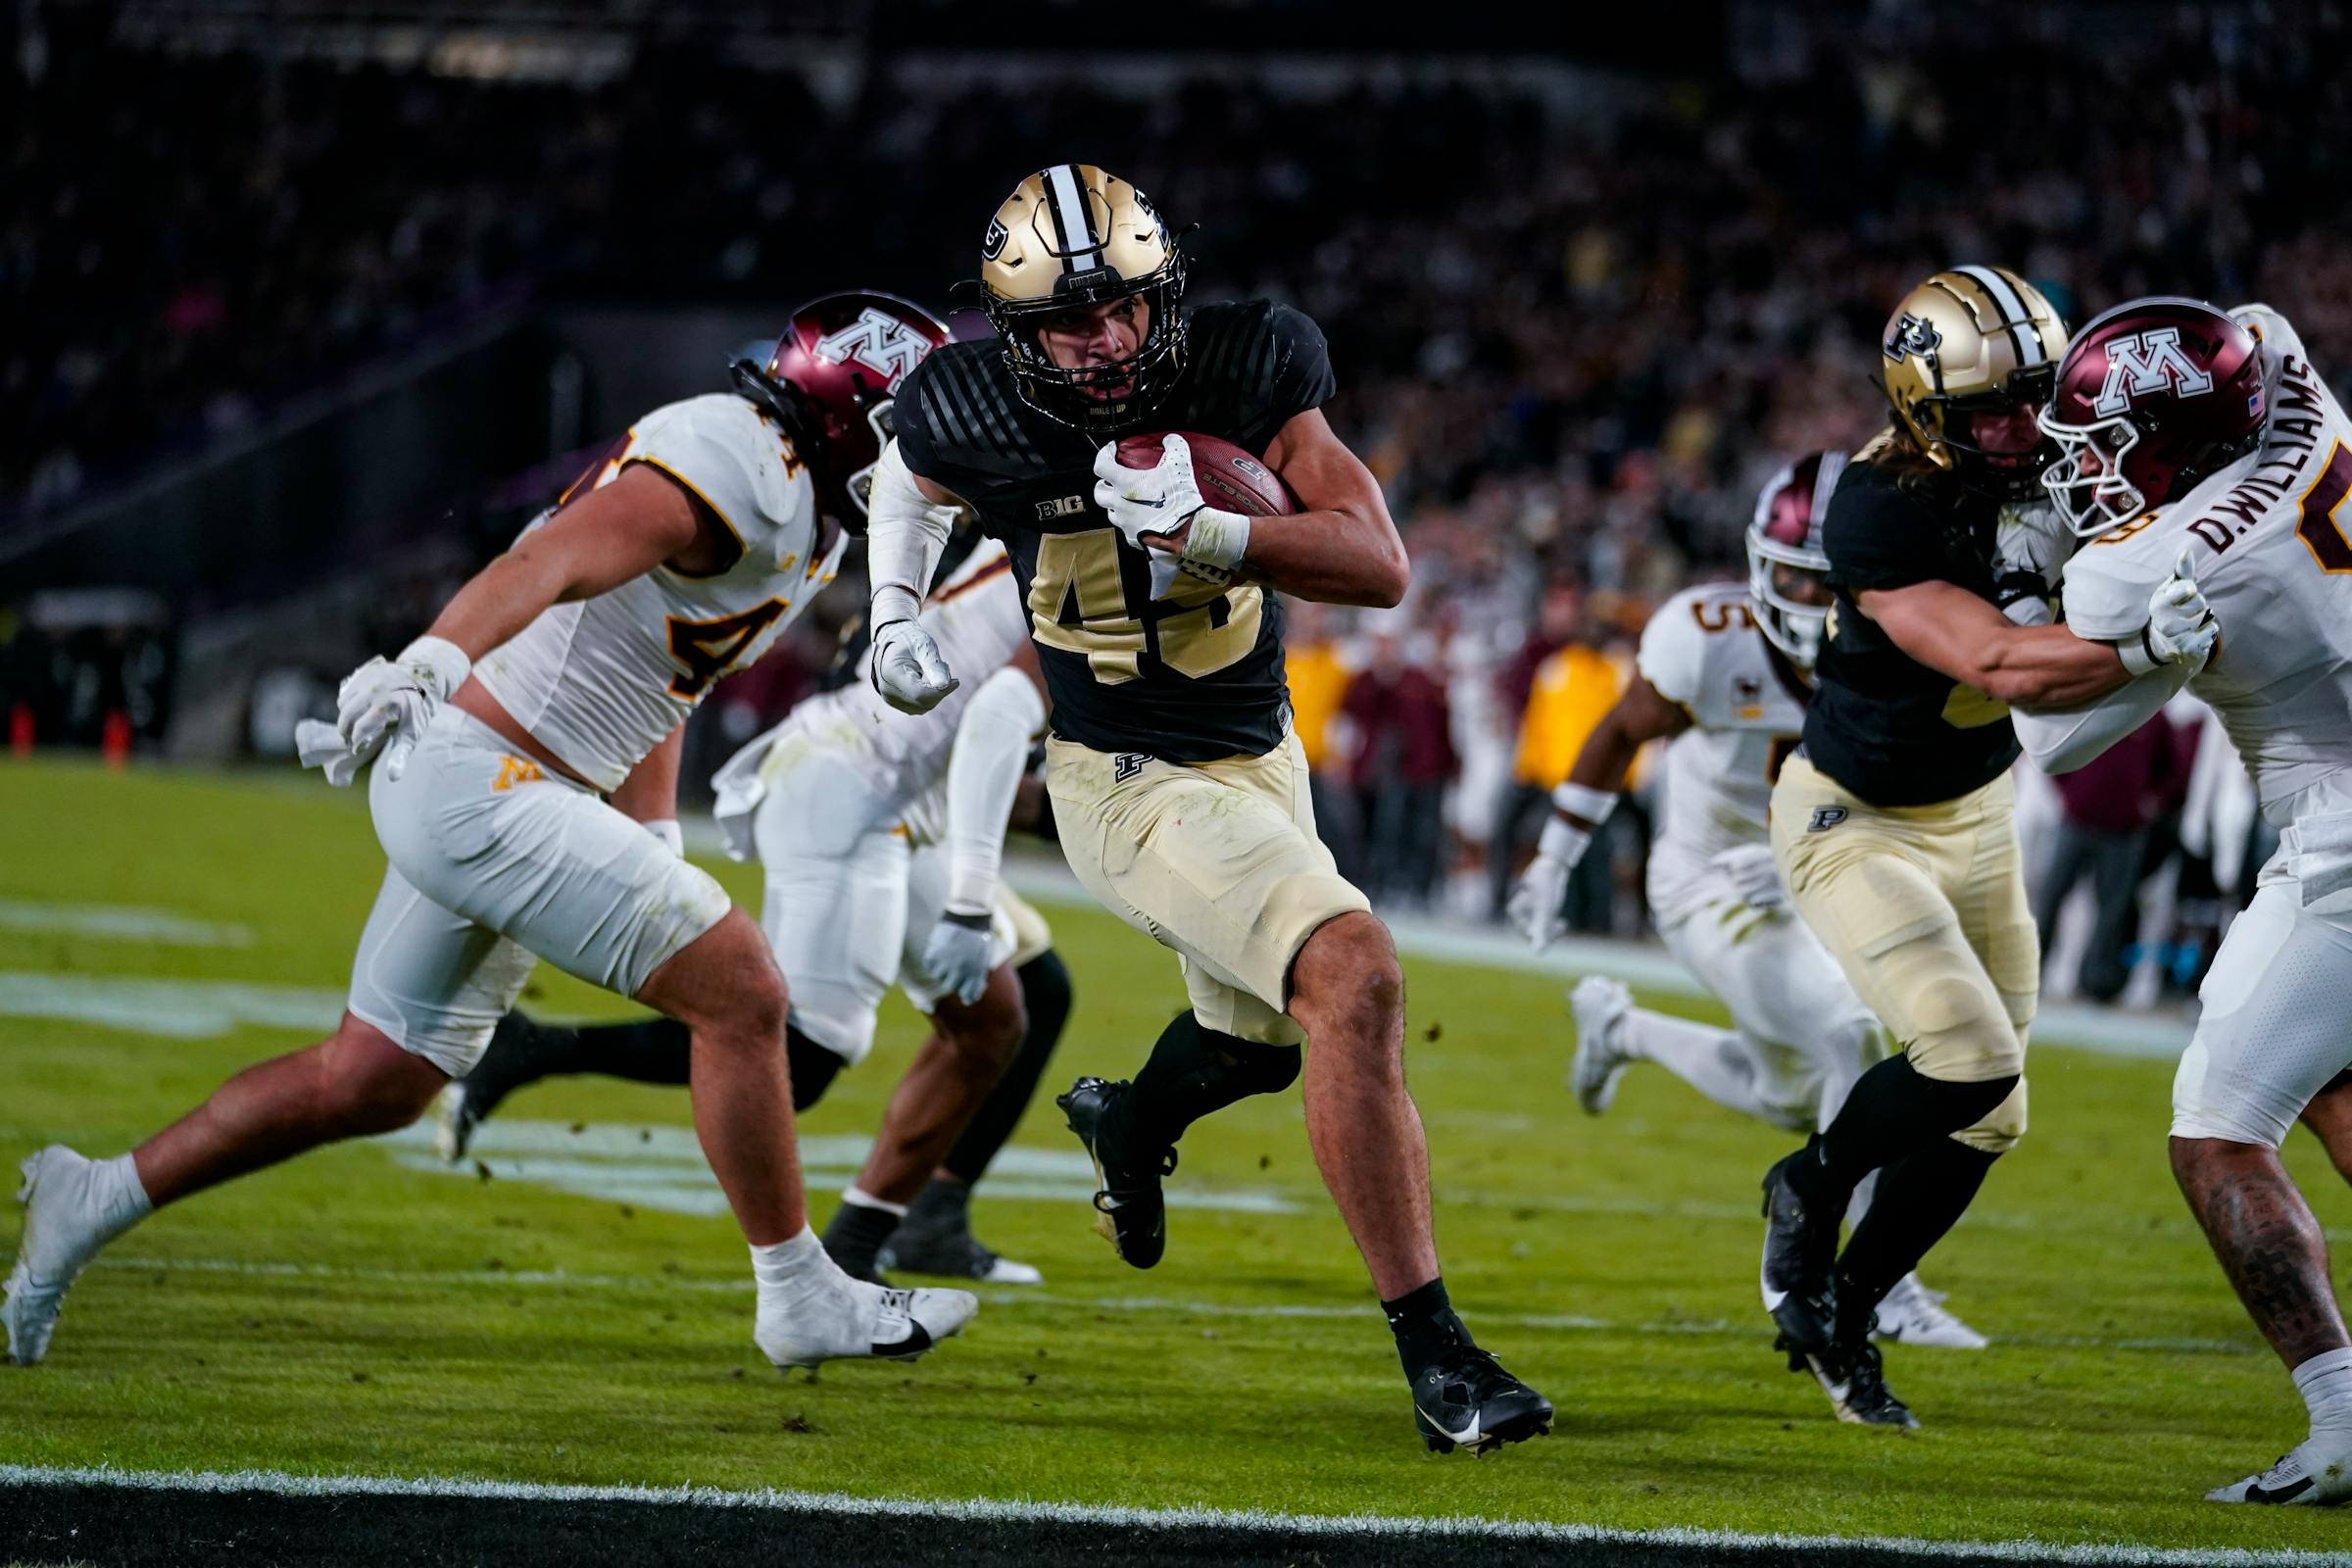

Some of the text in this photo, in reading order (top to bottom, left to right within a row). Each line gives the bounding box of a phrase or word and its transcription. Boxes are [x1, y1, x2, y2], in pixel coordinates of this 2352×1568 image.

[813, 306, 933, 398] M
[2093, 327, 2214, 418] M
[1090, 404, 1126, 416] BOILE UP
[2186, 354, 2324, 555] D.WILLIAMS
[1027, 527, 1264, 685] 45
[1114, 752, 1154, 783] P
[1807, 805, 1849, 832] P
